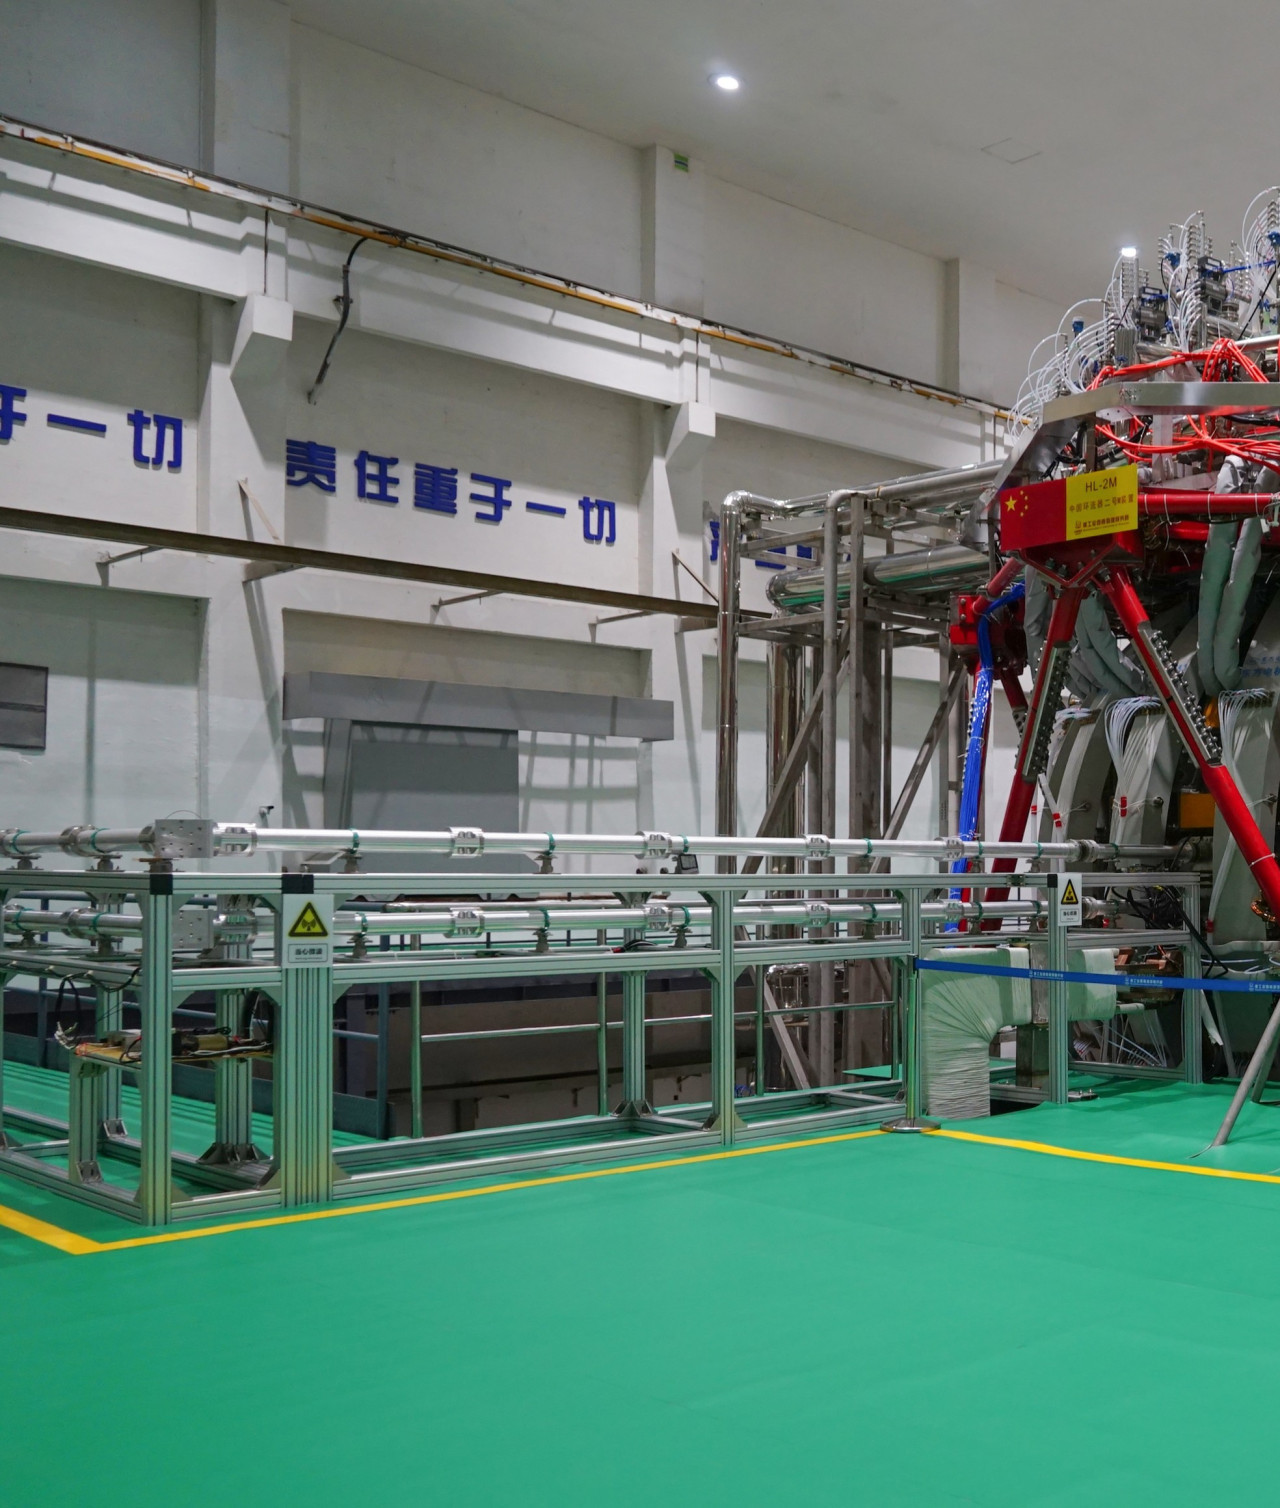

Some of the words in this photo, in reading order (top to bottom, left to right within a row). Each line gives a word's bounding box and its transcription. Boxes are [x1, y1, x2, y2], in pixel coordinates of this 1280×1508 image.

[286, 440, 617, 544] 责任重于一切
[1085, 476, 1117, 493] HL-2M
